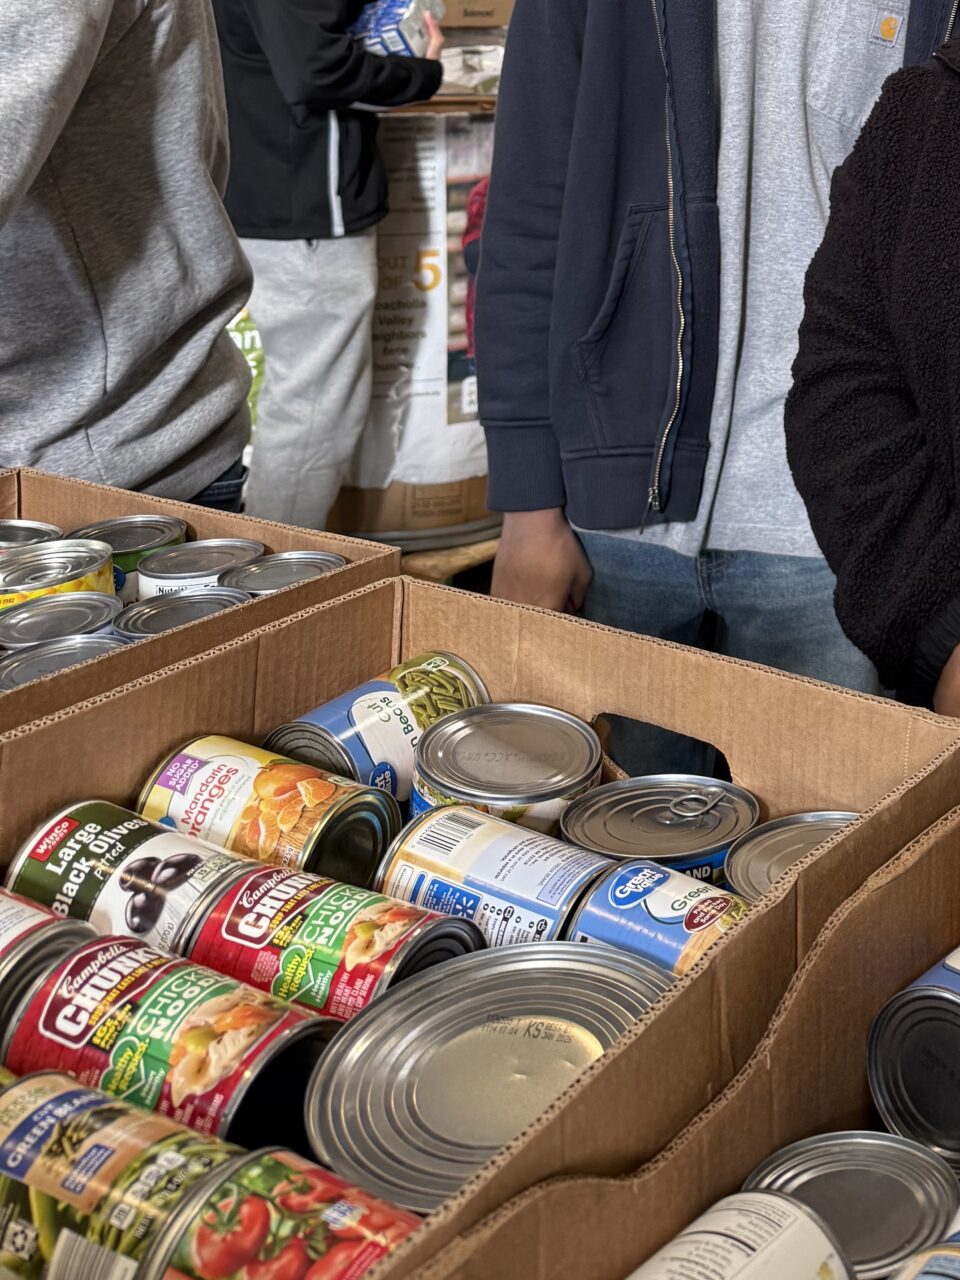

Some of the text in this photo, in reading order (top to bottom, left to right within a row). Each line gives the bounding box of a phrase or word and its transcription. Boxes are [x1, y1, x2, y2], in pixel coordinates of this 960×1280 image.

[414, 249, 442, 291] 5
[374, 299, 427, 311] oachella
[372, 330, 427, 342] eighbors
[367, 702, 392, 723] Cut
[166, 762, 181, 777] NO
[168, 758, 194, 786] SUGAR
[181, 763, 228, 825] Mandarin
[45, 822, 102, 876] Large
[52, 818, 149, 916] Black Olives
[93, 841, 127, 880] Pitted
[615, 867, 658, 898] Great
[632, 871, 665, 893] Value
[671, 884, 715, 911] Green
[238, 872, 318, 938] CHUN
[303, 887, 353, 944] CHICK
[316, 892, 369, 945] NOOD
[277, 953, 302, 1000] Healthy
[136, 970, 200, 1034] CHICK
[106, 1047, 135, 1095] Healthy
[6, 1114, 57, 1168] GREEN
